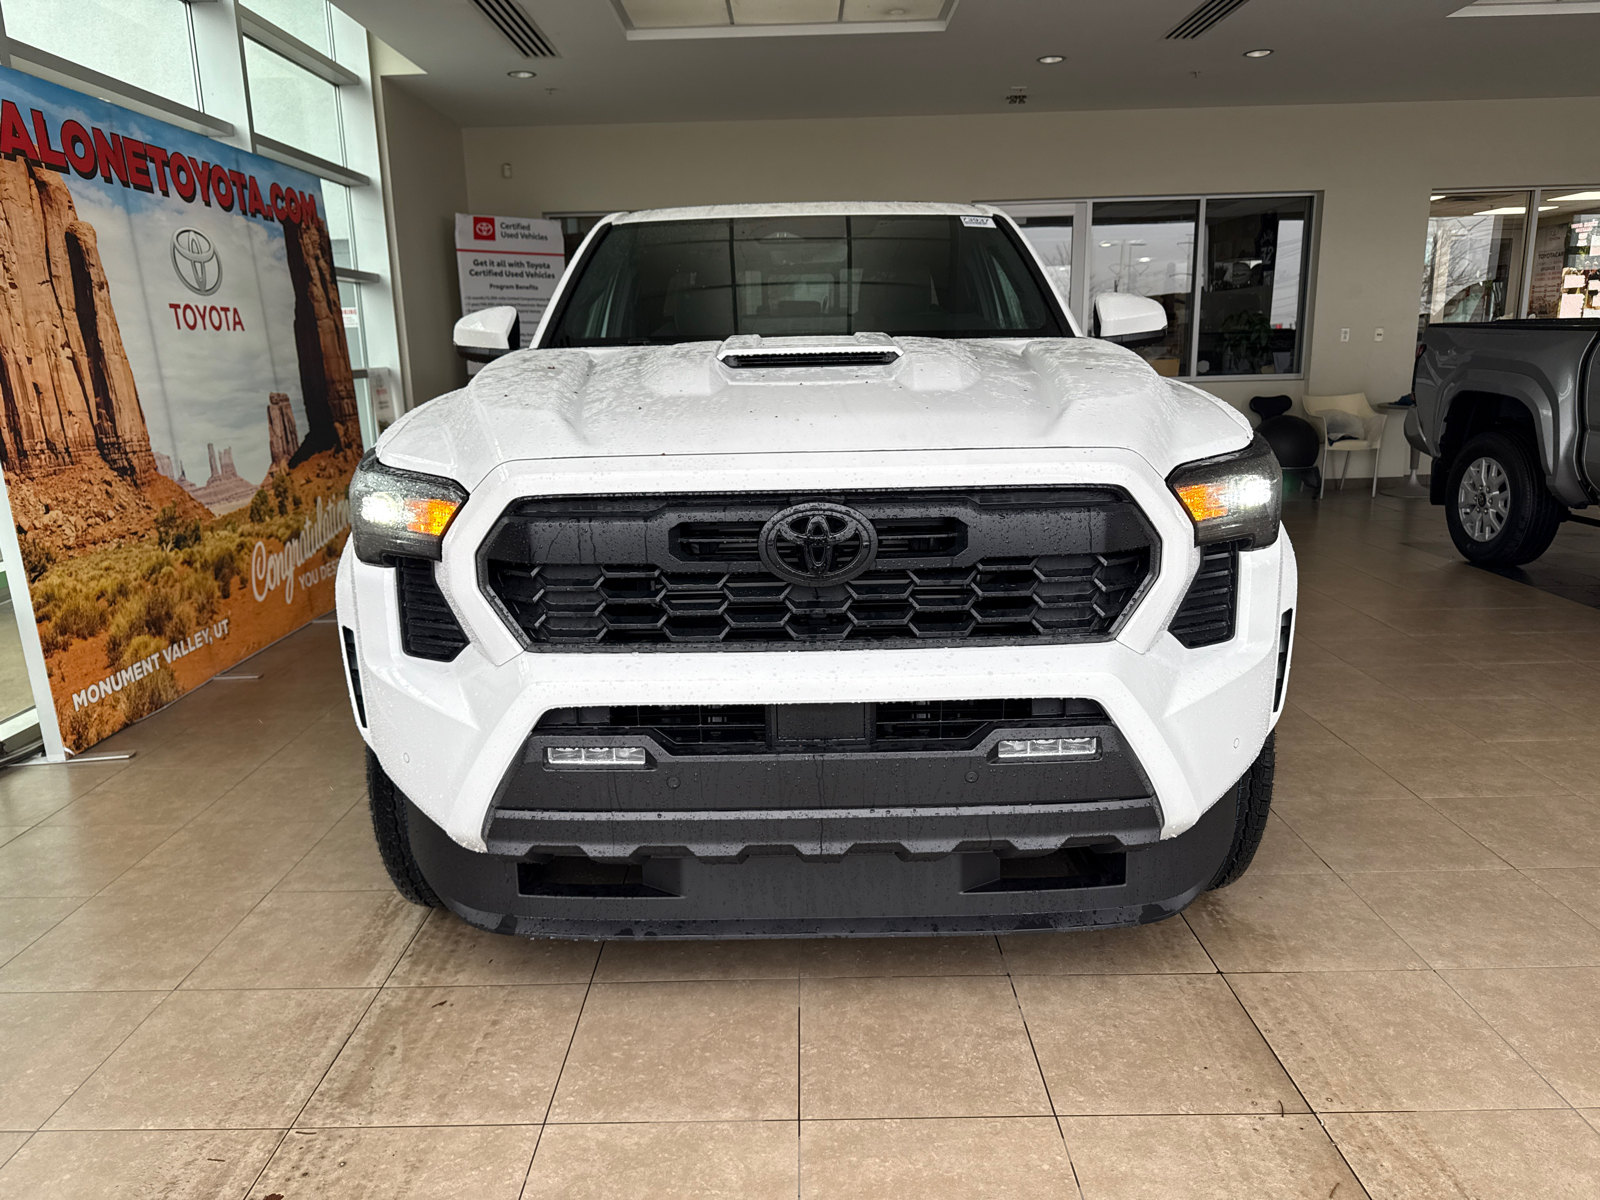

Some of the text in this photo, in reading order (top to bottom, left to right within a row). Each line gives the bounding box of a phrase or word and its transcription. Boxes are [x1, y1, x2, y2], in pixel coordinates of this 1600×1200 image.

[0, 98, 321, 226] ALONETOYOTA.COM
[500, 222, 530, 231] Certified
[501, 231, 549, 241] Used Vehicles
[469, 269, 556, 279] Certified Used Vehicles
[473, 259, 550, 271] Get it all with Toyota
[489, 283, 515, 291] Program
[168, 303, 245, 332] TOYOTA
[251, 494, 352, 605] Congratulation
[298, 559, 338, 590] YOU DES
[72, 618, 230, 712] MONUMENT VALLEY, UT
